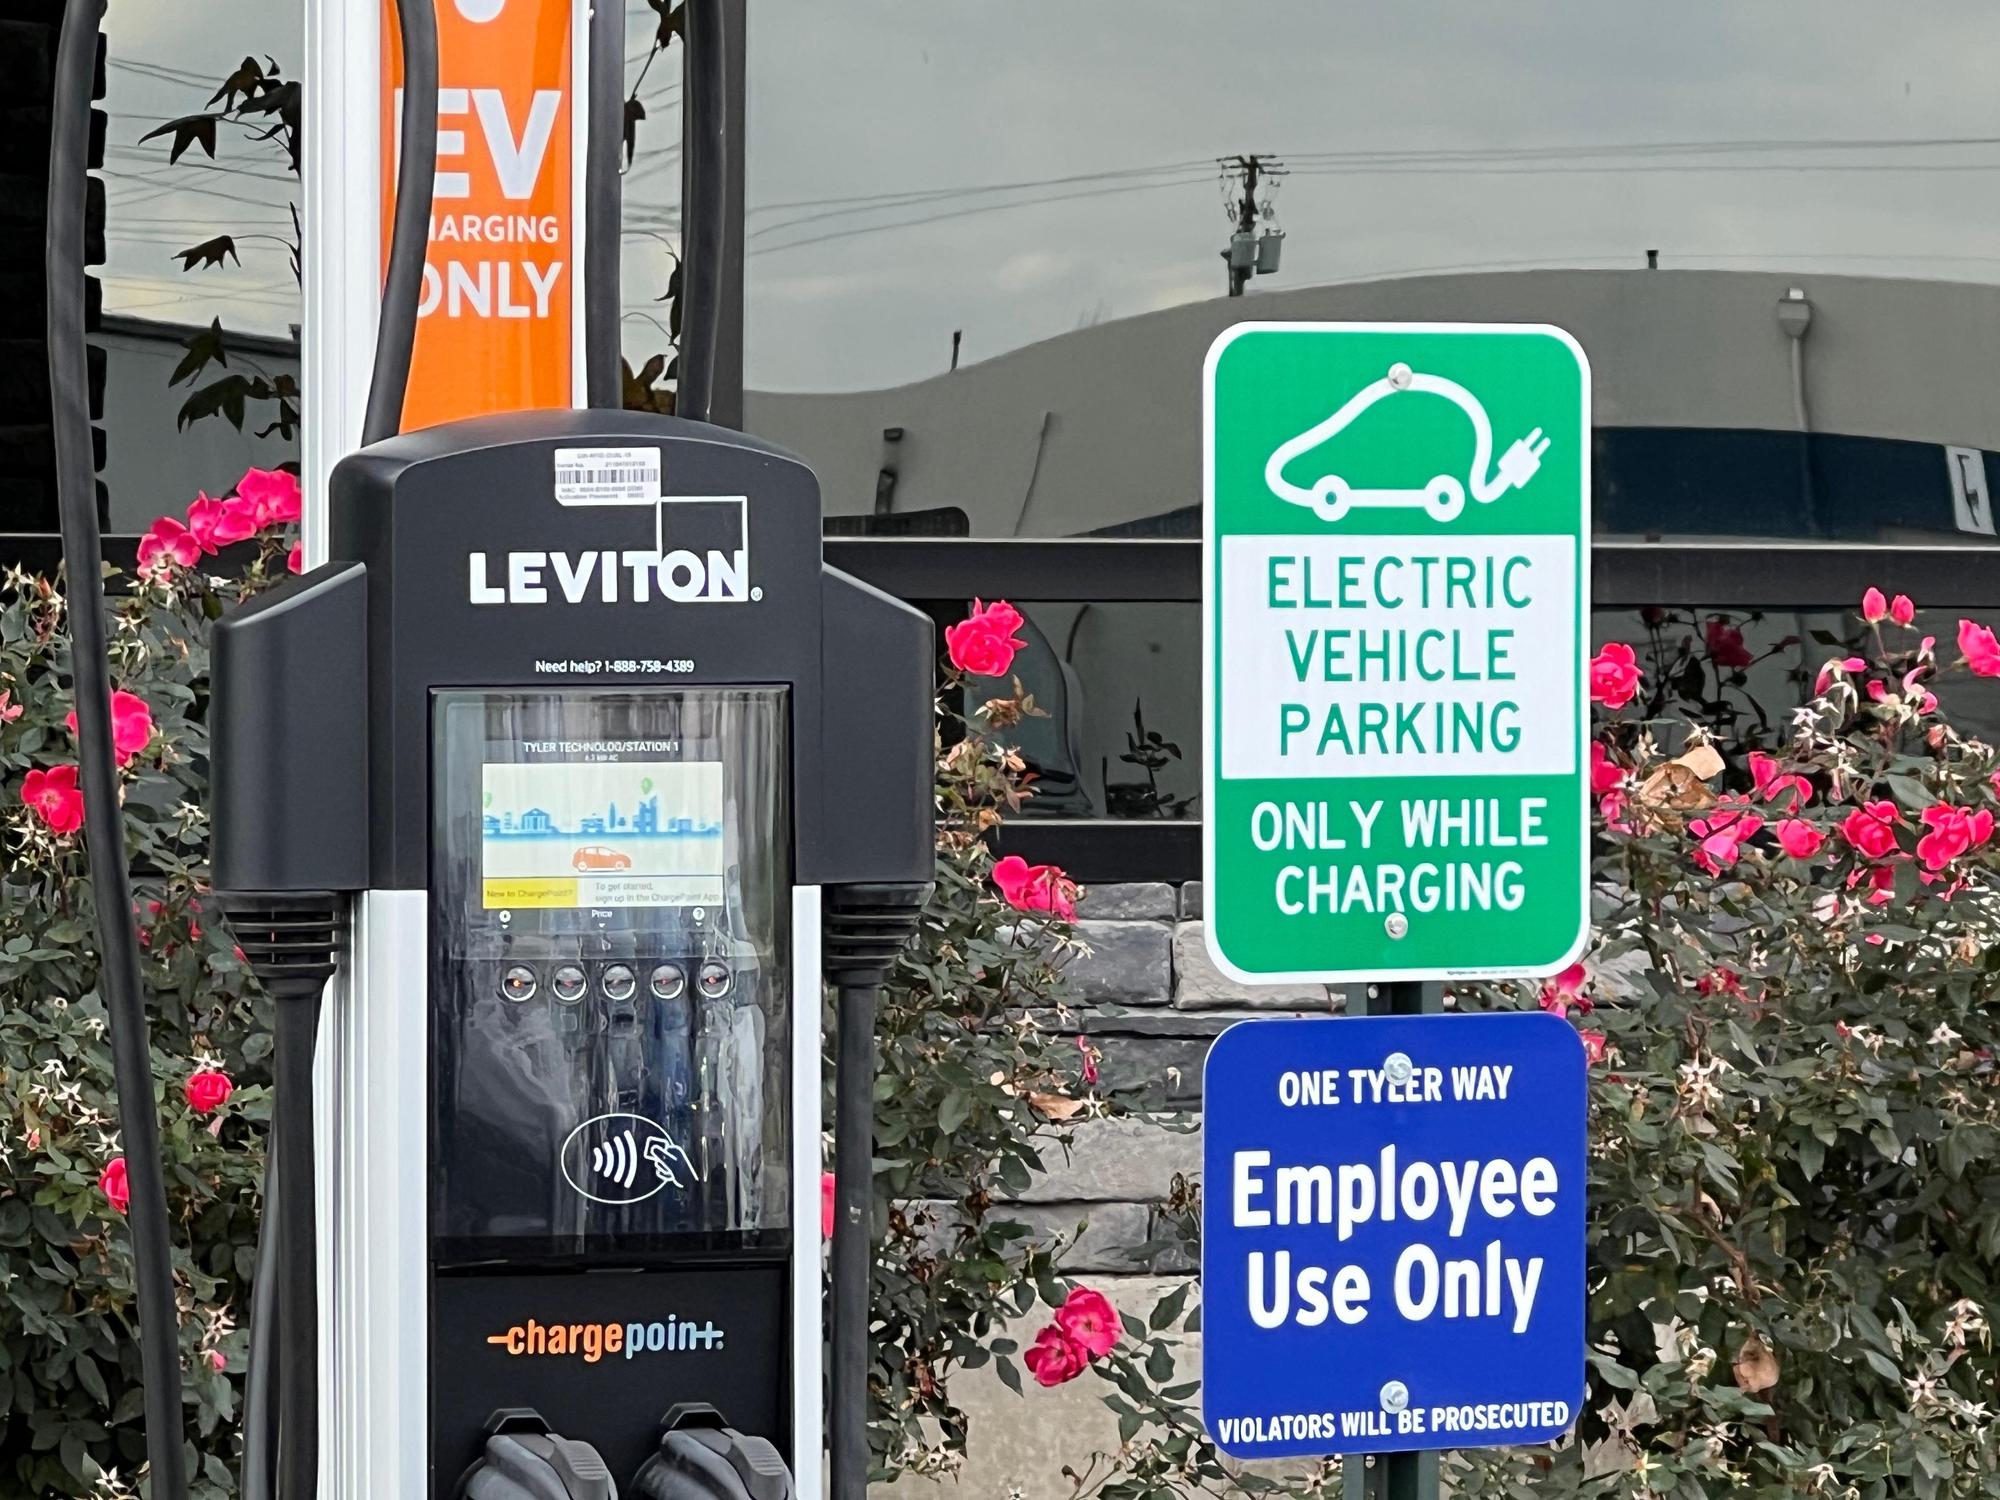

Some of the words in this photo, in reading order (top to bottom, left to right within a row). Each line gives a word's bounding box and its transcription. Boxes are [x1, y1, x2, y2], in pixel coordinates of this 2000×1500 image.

[429, 214, 559, 243] ARGING
[469, 550, 749, 604] LEVITON
[1268, 556, 1533, 609] ELECTRIC
[535, 660, 568, 673] Need
[569, 660, 602, 674] help?
[604, 660, 695, 673] 1-888-758-4389
[1285, 629, 1516, 682] VEHICLE
[523, 742, 556, 753] TYLER
[1280, 700, 1522, 756] PARKING
[1251, 800, 1384, 851] ONLY
[1401, 797, 1549, 848] WHILE
[591, 909, 613, 919] Price
[1275, 862, 1525, 915] CHARGING
[1279, 1071, 1341, 1107] ONE
[1348, 1066, 1443, 1104] TYLER
[1451, 1065, 1513, 1101] WAY
[1233, 1144, 1558, 1241] Employee
[1248, 1250, 1371, 1329] Use
[1394, 1240, 1544, 1334] Only
[1218, 1413, 1336, 1444] VIOLATORS
[1341, 1409, 1392, 1437] WILL
[1399, 1407, 1426, 1434] BE
[1432, 1401, 1570, 1432] PROSECUTED
